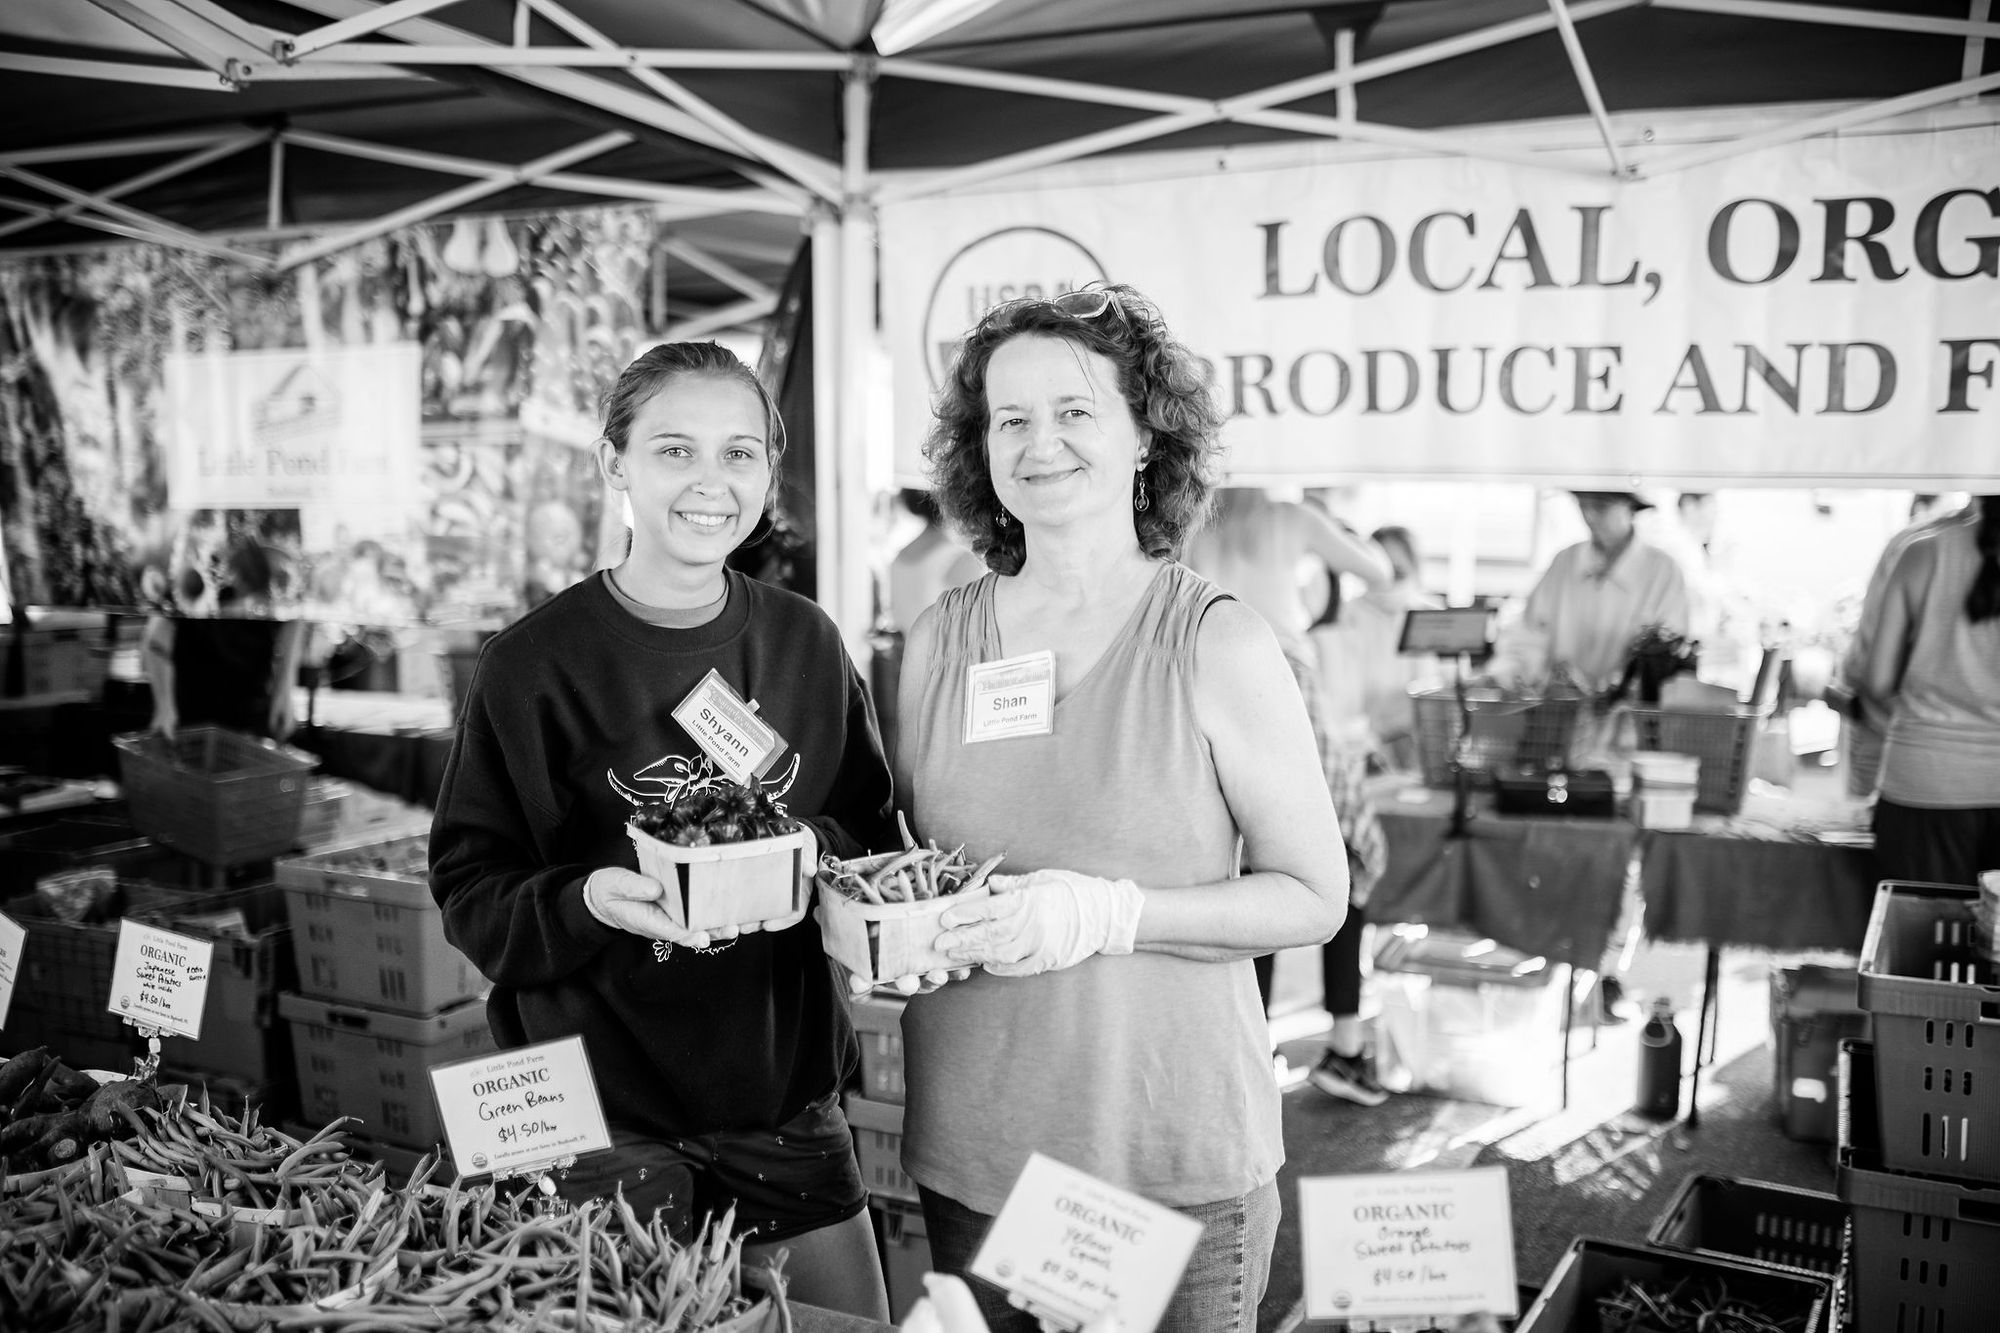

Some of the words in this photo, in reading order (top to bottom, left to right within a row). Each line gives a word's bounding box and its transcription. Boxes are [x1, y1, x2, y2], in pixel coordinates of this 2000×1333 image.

[1255, 205, 1662, 307] LOCAL,
[1707, 187, 2000, 285] ORG
[1203, 344, 1624, 418] RODUCE
[1655, 340, 1898, 416] AND
[993, 696, 1027, 711] Shan
[692, 719, 708, 737] Little
[708, 736, 724, 753] Pond
[724, 752, 741, 768] Farm
[700, 708, 749, 757] Shyann
[140, 945, 187, 967] ORGANIC
[487, 1063, 505, 1073] Little
[507, 1059, 524, 1069] Pond
[526, 1055, 545, 1064] Farm
[473, 1068, 550, 1097] ORGANIC
[479, 1102, 523, 1121] Green
[525, 1091, 565, 1109] Beans
[1055, 1196, 1145, 1244] ORGANIC
[1353, 1203, 1455, 1223] ORGANIC
